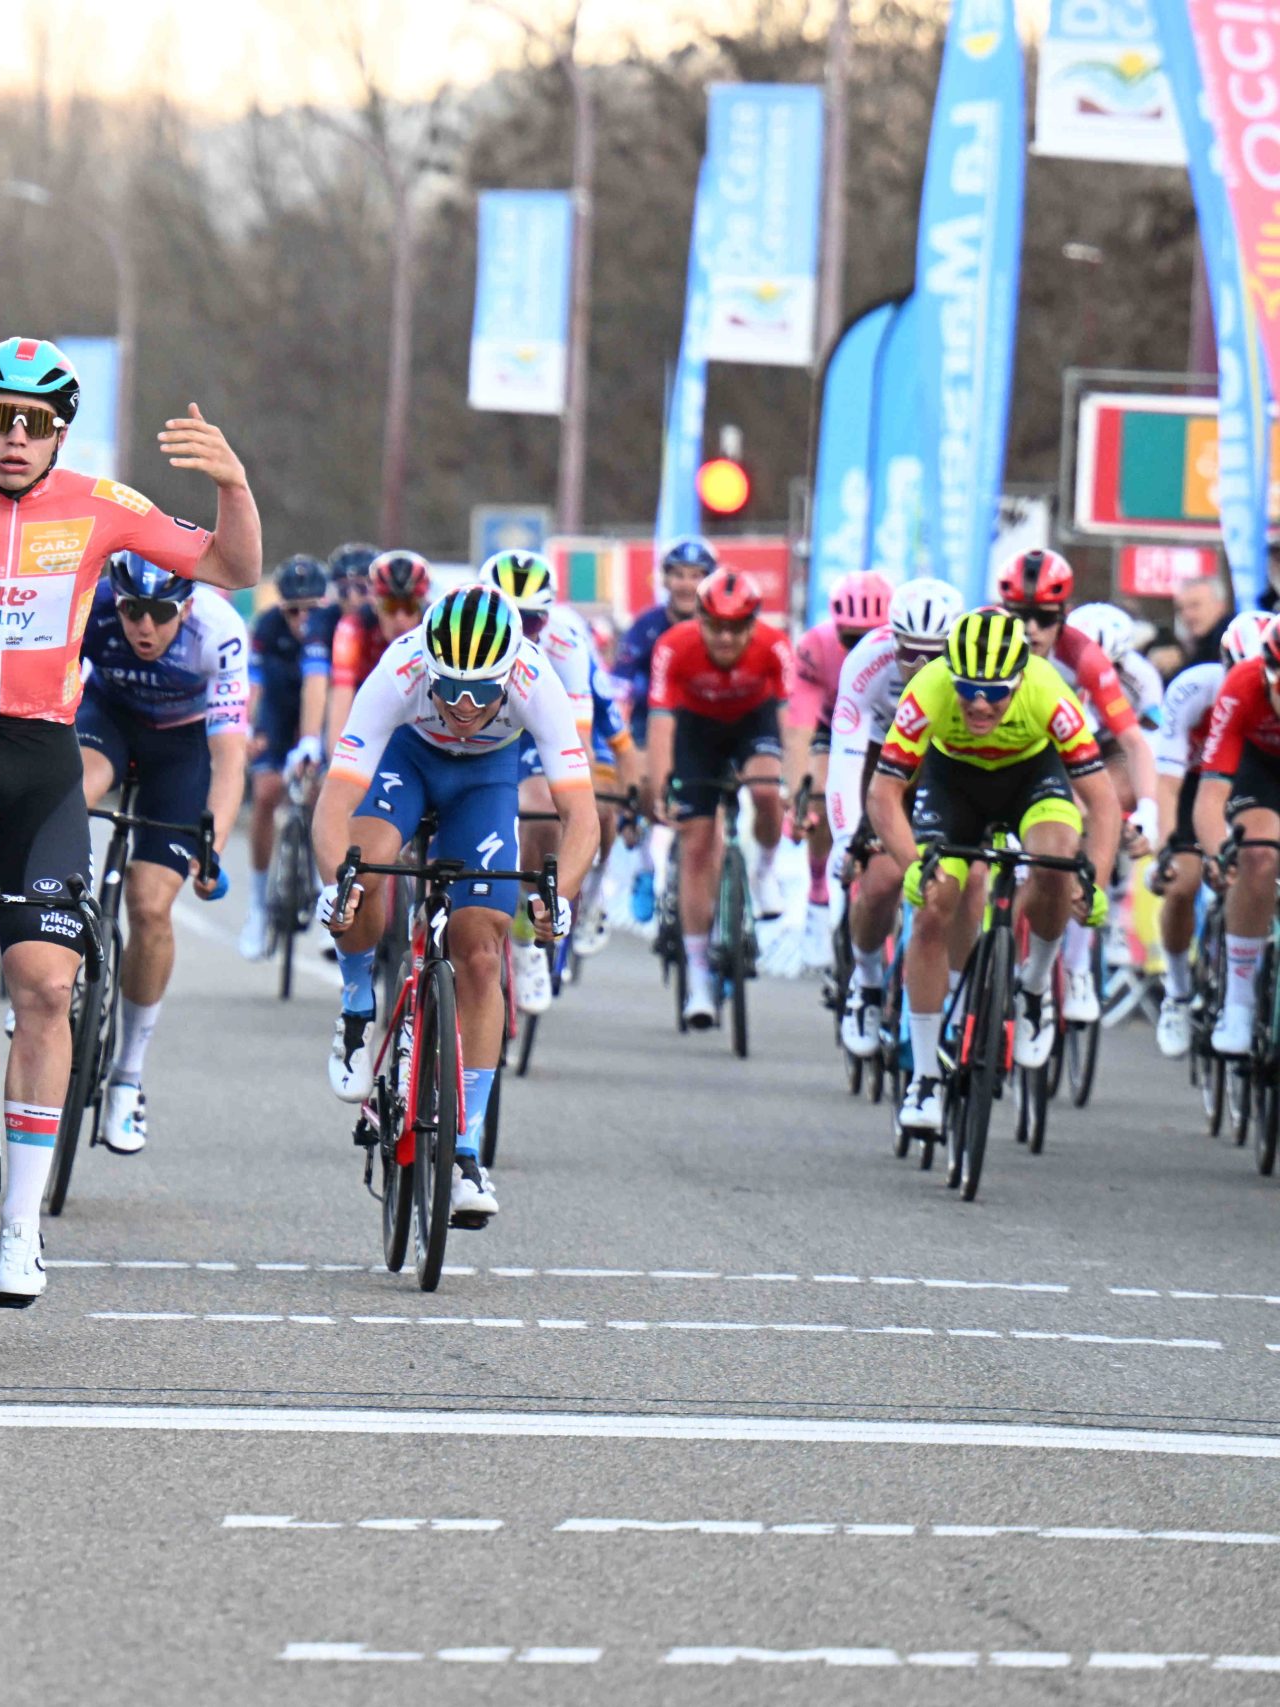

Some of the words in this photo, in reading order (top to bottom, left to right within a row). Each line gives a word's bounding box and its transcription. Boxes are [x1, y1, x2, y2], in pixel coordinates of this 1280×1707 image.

[29, 539, 80, 553] GARD
[896, 700, 929, 735] B!
[1051, 697, 1080, 741] B!
[1201, 696, 1239, 764] ARKEA
[40, 912, 84, 933] viking
[41, 922, 77, 938] lotto
